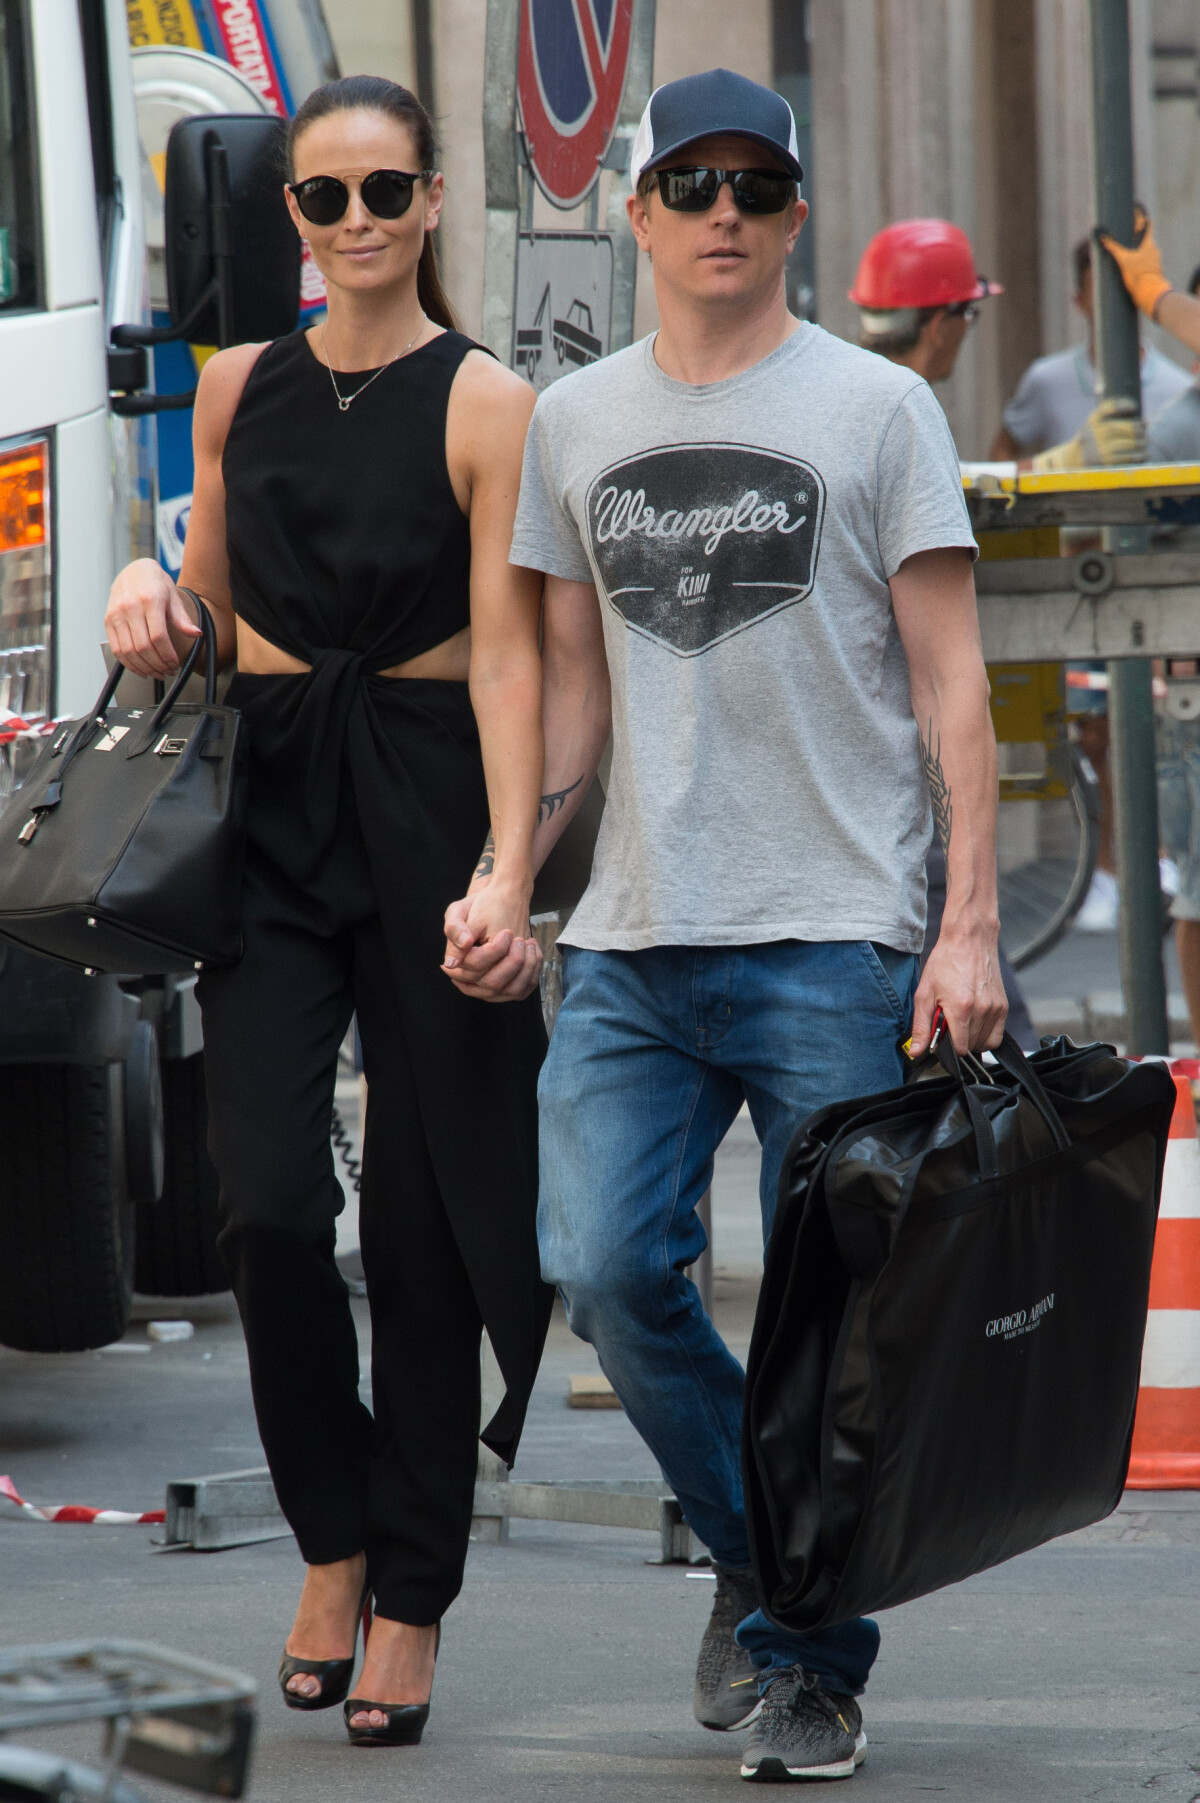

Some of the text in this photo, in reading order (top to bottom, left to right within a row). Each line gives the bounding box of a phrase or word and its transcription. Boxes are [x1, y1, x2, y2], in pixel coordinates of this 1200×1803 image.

[594, 486, 807, 555] Wrangler
[680, 566, 694, 574] FOR
[677, 572, 711, 598] KIMI
[985, 1309, 1027, 1338] GIORGIO
